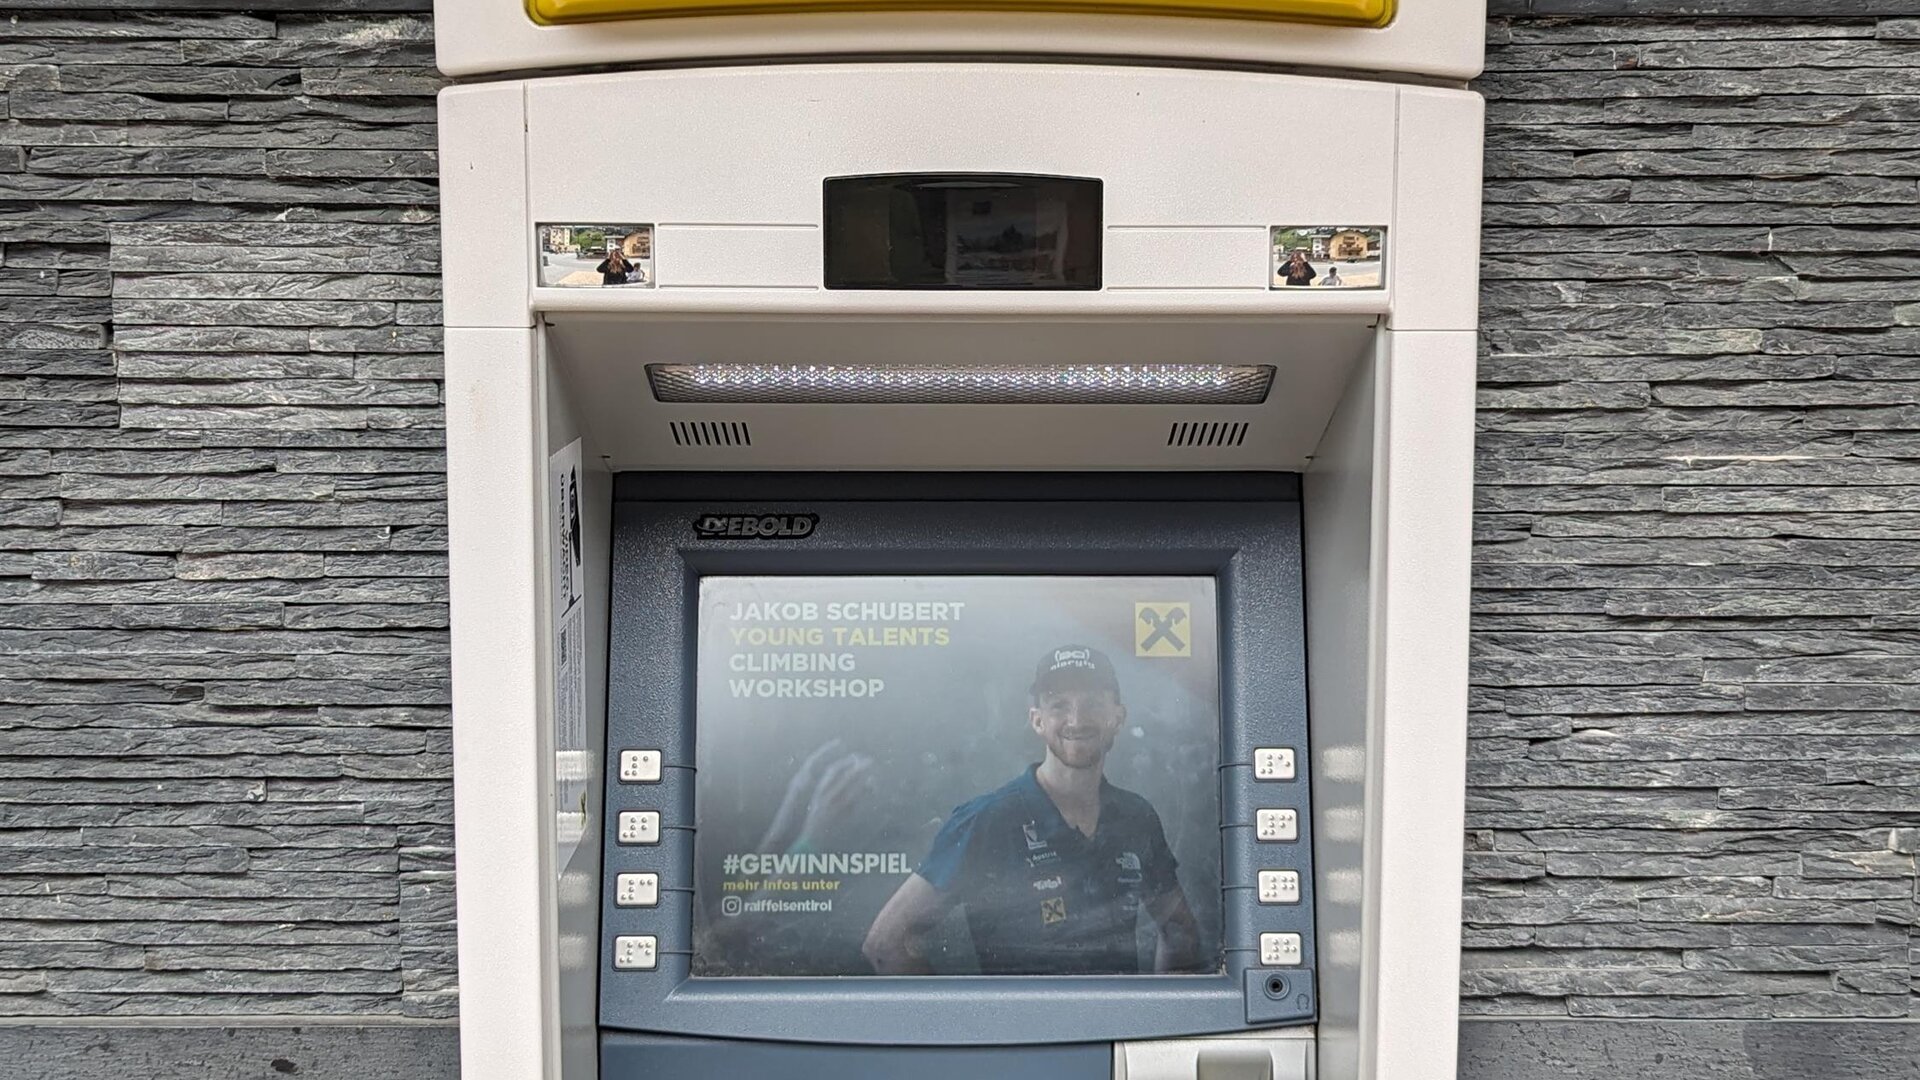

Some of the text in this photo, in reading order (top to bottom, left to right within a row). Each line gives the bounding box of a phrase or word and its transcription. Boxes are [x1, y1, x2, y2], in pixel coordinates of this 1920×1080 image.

[729, 602, 966, 621] JAKOB SCHUBERT
[730, 627, 950, 646] YOUNG TALENTS
[729, 653, 856, 672] CLIMBING
[729, 678, 885, 698] WORKSHOP
[723, 853, 912, 875] #GEWINNSPIEL
[723, 879, 759, 891] mehr
[802, 880, 840, 891] unter
[744, 899, 833, 912] raiffeisentirol
